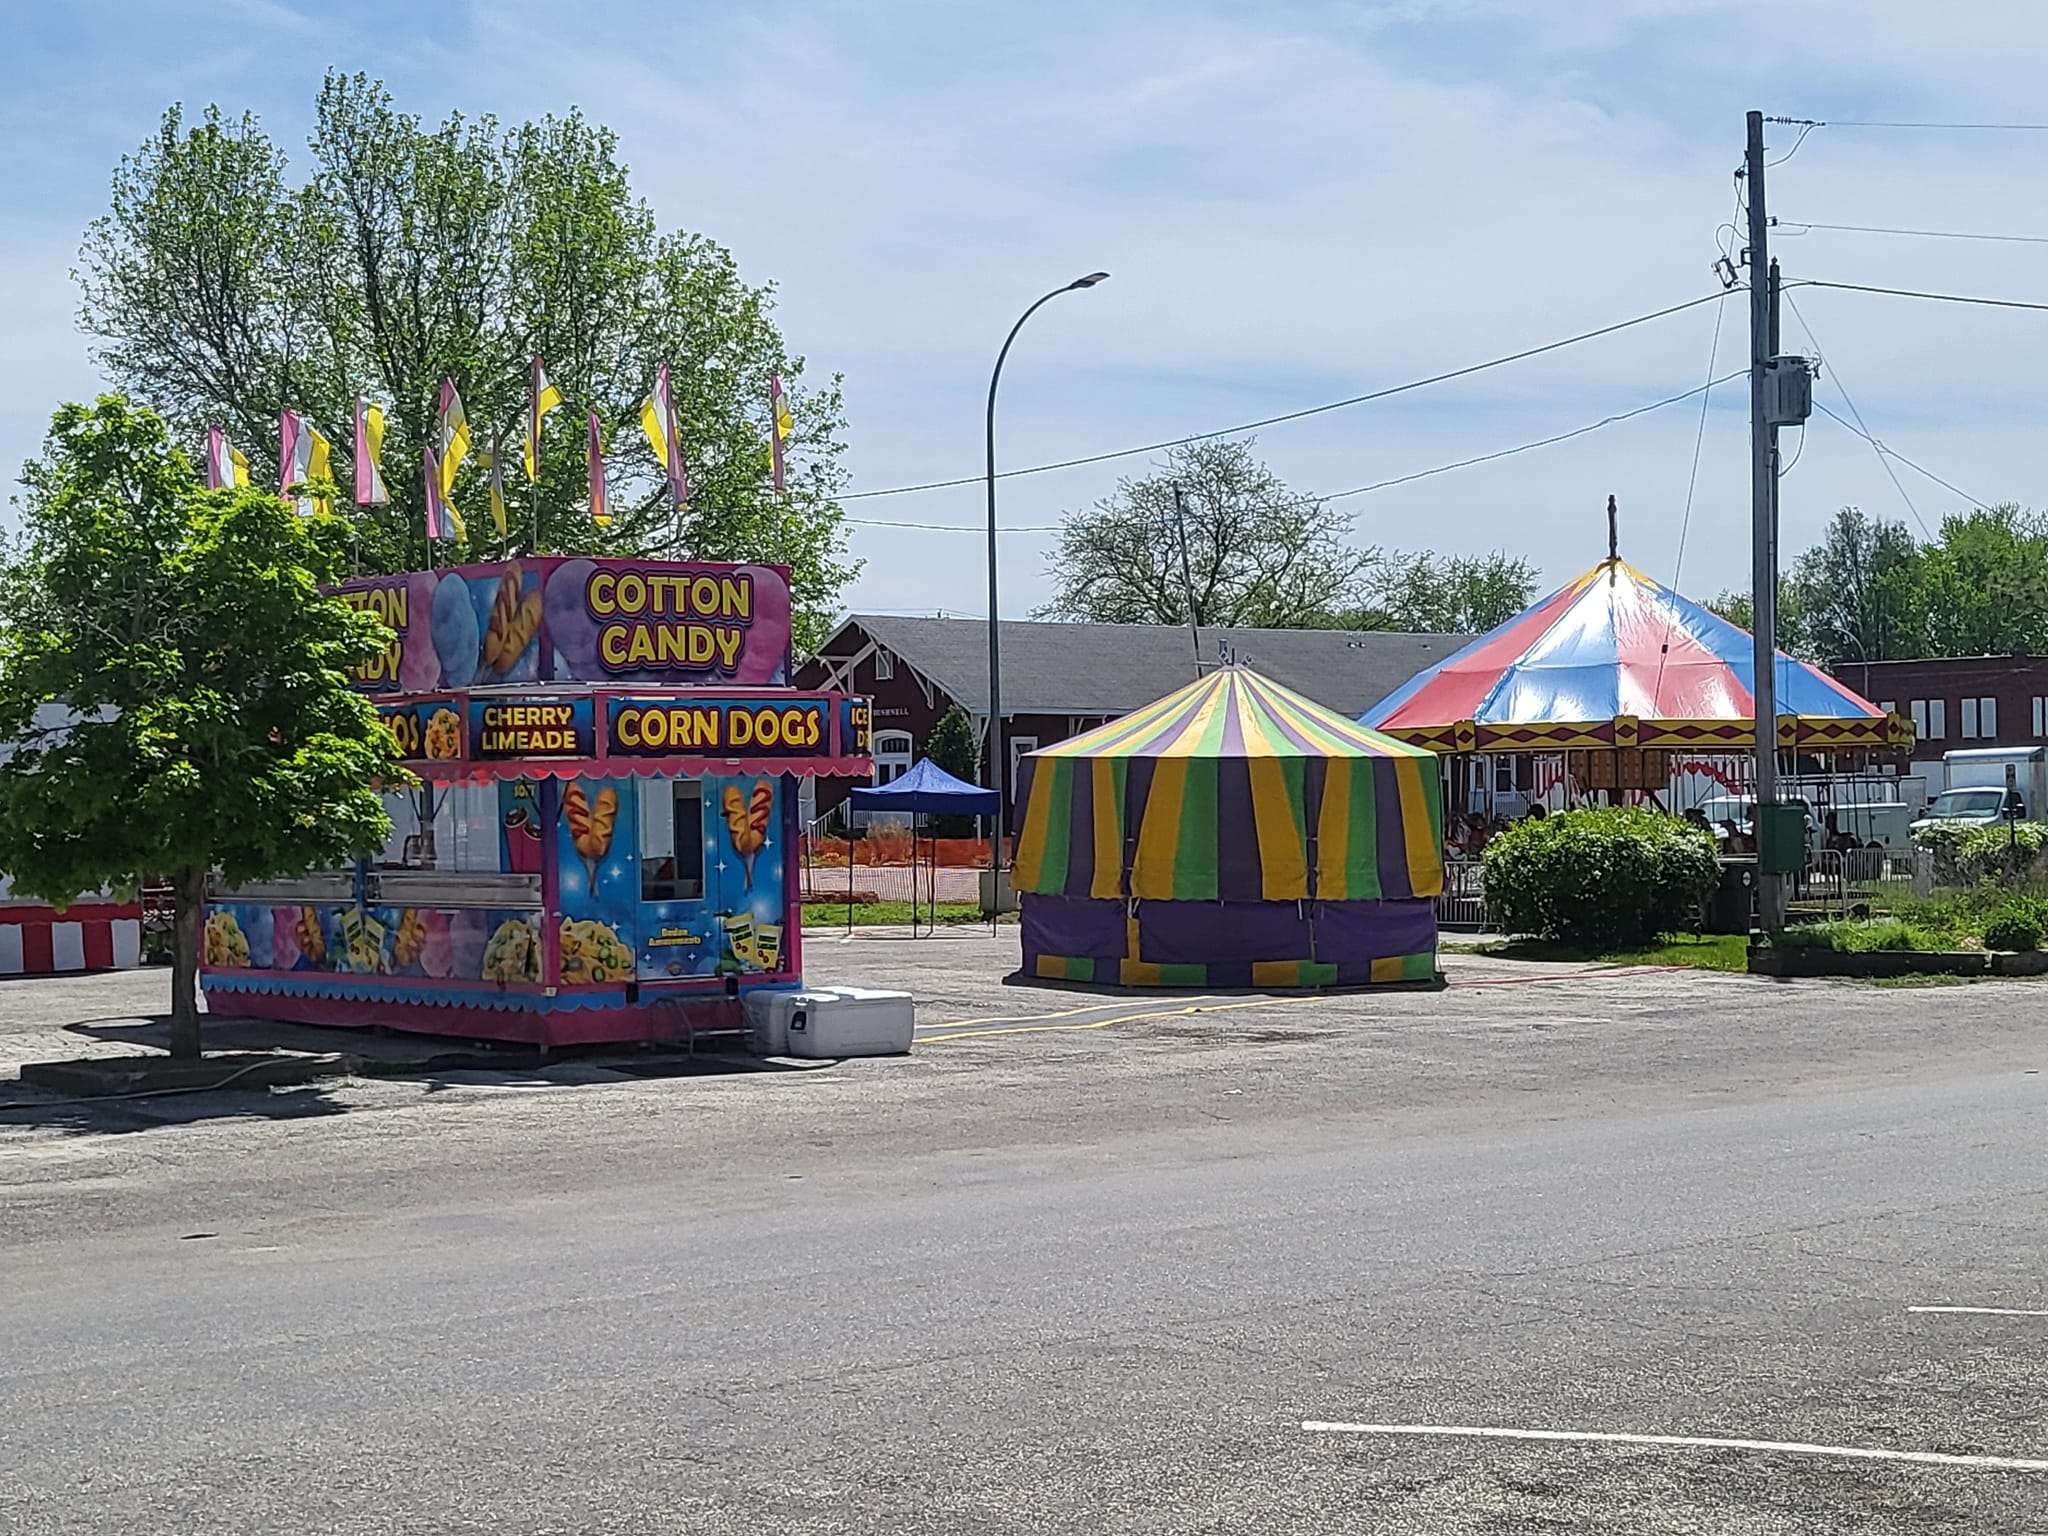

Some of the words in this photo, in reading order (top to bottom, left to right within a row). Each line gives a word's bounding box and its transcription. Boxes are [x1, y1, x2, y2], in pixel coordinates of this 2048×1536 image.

[590, 573, 750, 618] COTTON
[602, 624, 741, 666] CANDY
[484, 706, 572, 726] CHERRY
[617, 709, 719, 747] CORN
[729, 709, 820, 747] DOGS
[482, 730, 577, 750] LIMEADE
